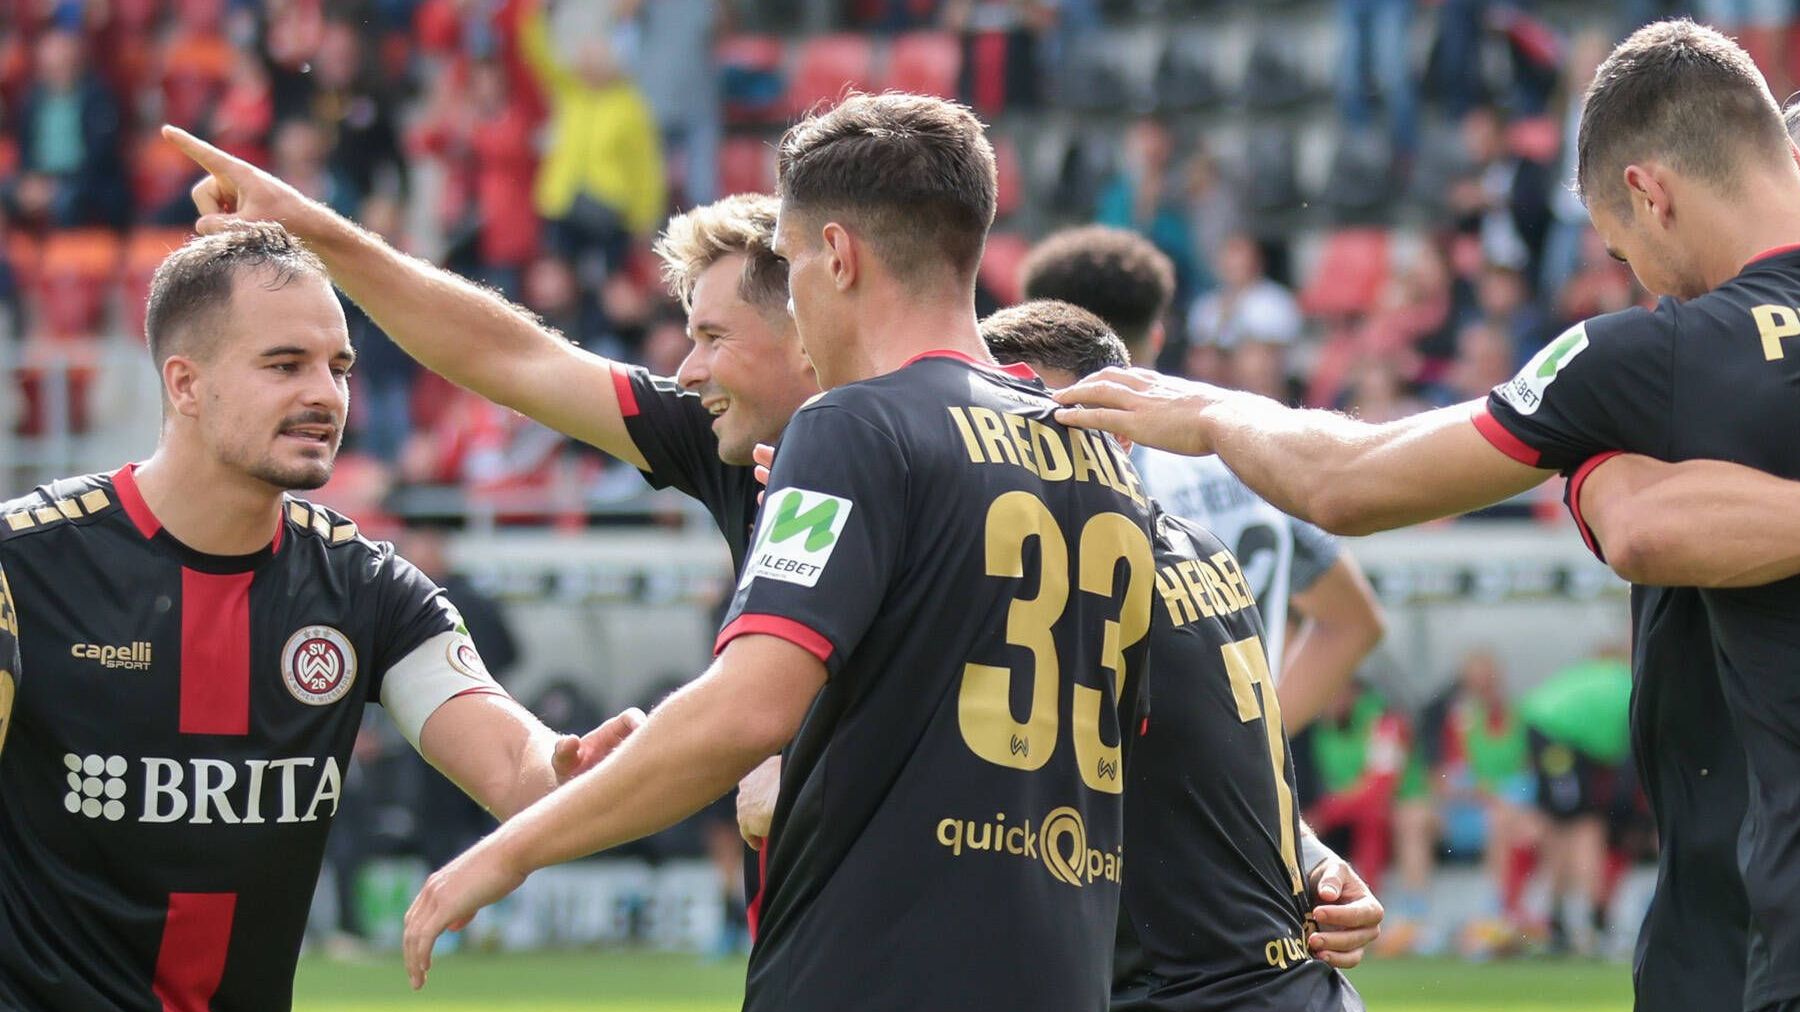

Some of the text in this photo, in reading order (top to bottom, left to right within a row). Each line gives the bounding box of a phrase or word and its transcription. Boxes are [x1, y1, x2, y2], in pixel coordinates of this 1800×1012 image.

[948, 406, 1147, 508] IREDALE
[71, 641, 152, 665] capelli
[106, 660, 152, 670] SPORT
[309, 643, 326, 655] SV
[958, 490, 1155, 794] 33
[312, 678, 327, 689] 26
[138, 756, 342, 824] BRITA
[1221, 635, 1303, 895] 7
[936, 812, 1039, 859] quick
[1087, 845, 1122, 884] pai
